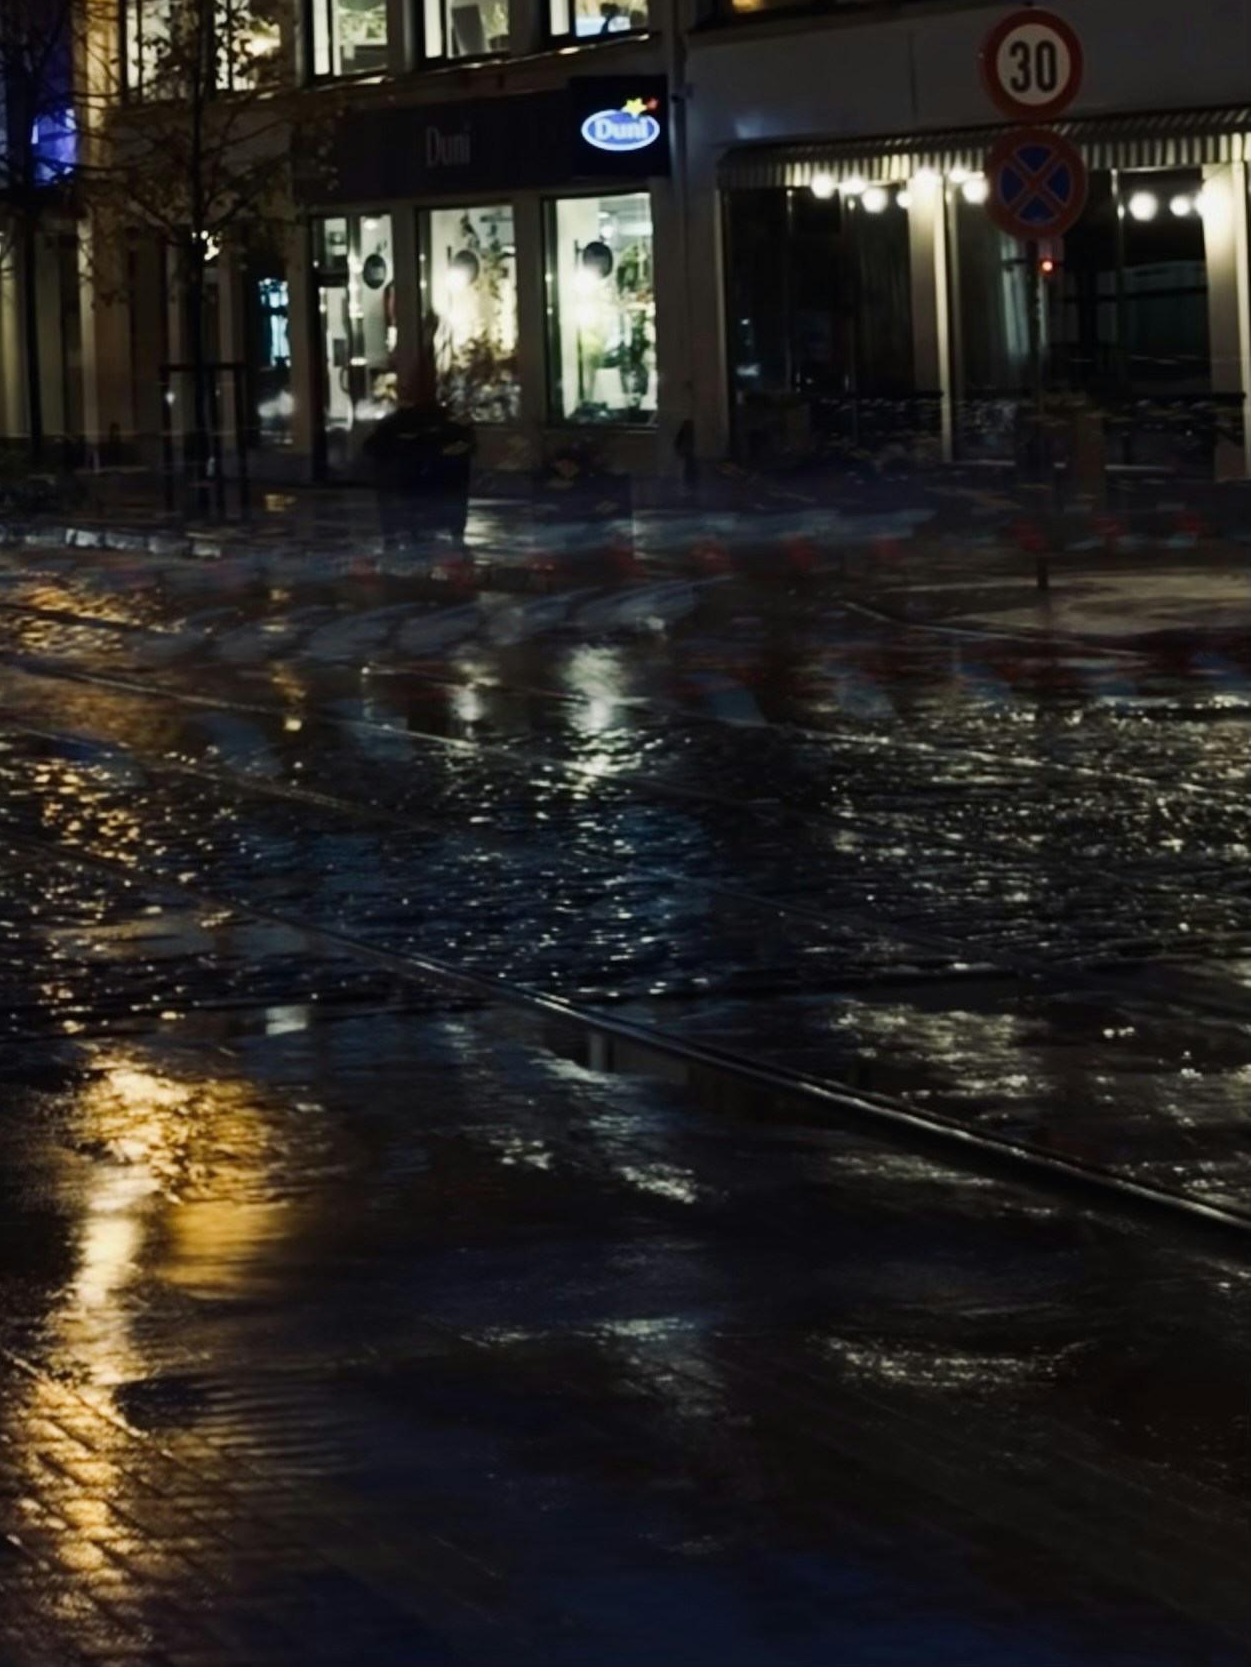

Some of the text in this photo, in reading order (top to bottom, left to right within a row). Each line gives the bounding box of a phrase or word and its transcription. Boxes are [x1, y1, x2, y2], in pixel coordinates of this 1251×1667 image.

[1010, 40, 1057, 94] 30
[426, 122, 471, 167] Duni
[594, 116, 648, 141] Duni
